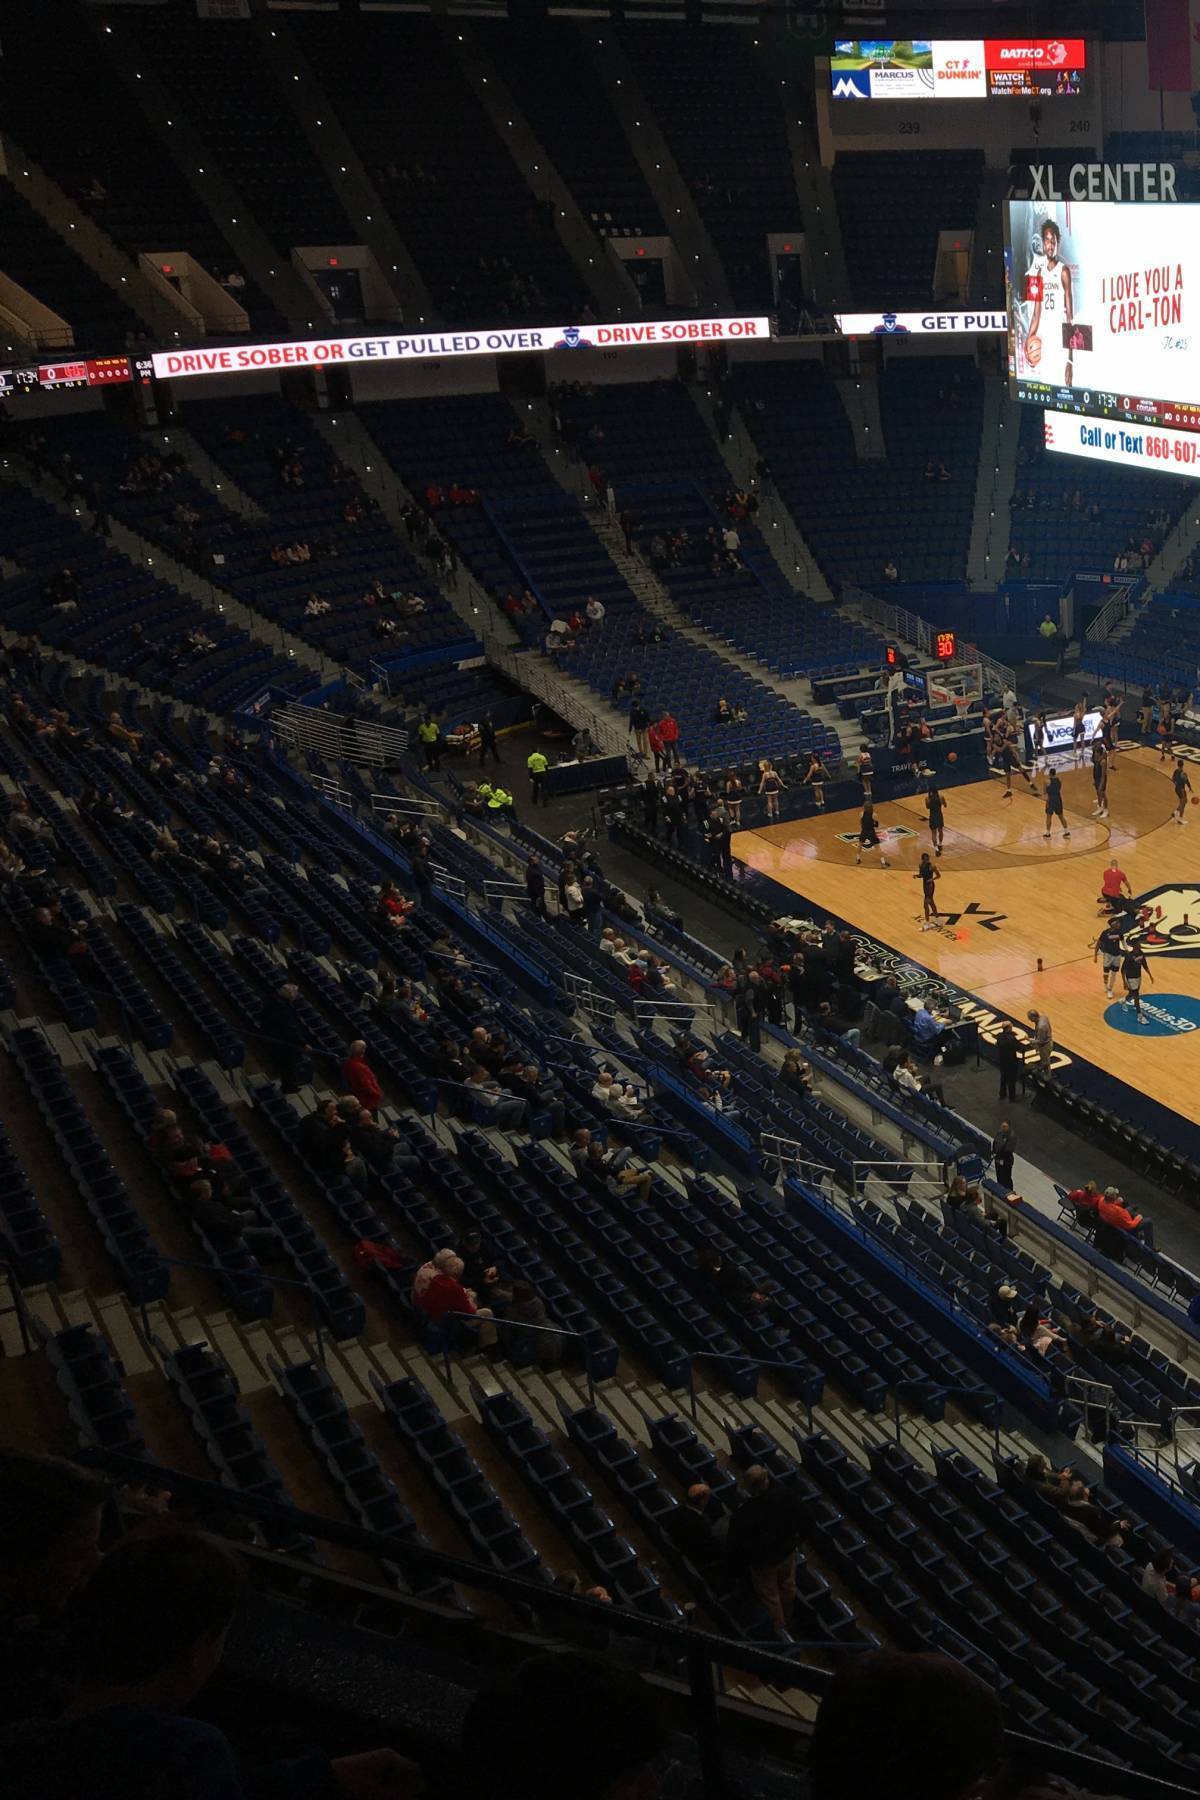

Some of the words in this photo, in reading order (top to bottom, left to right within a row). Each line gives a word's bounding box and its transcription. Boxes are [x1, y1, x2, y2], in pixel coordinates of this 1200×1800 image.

[1000, 49, 1044, 59] DATTCO
[946, 61, 960, 69] CT
[875, 71, 914, 79] MARCUS
[938, 70, 982, 79] DUNKIN'
[994, 73, 1024, 81] WATCH
[991, 87, 1052, 96] WatchForMeCT.org
[900, 122, 920, 134] 239
[1070, 120, 1090, 133] 240
[1029, 165, 1062, 200] XL
[1069, 163, 1177, 200] CENTER
[1102, 278, 1106, 303] I
[1111, 272, 1139, 302] LOVE
[1144, 265, 1169, 295] YOU
[1175, 263, 1183, 290] A
[1044, 294, 1055, 310] 25
[1110, 293, 1181, 334] CARL-TON
[921, 316, 958, 330] GET
[167, 351, 233, 373] DRIVE
[238, 343, 309, 367] SOBER
[314, 344, 344, 360] OR
[349, 340, 390, 358] GET
[398, 334, 481, 354] PULLED
[486, 332, 543, 350] OVER
[597, 324, 656, 343] DRIVE
[662, 322, 723, 339] SOBER
[728, 321, 756, 336] OR
[16, 371, 38, 384] 17:34
[47, 368, 56, 380] 0
[1083, 391, 1090, 404] 0
[1098, 393, 1118, 408] 17:34
[1124, 397, 1130, 409] 0
[1080, 424, 1102, 448] Call
[1104, 432, 1116, 449] or
[1119, 431, 1143, 454] Text
[938, 641, 953, 657] 30
